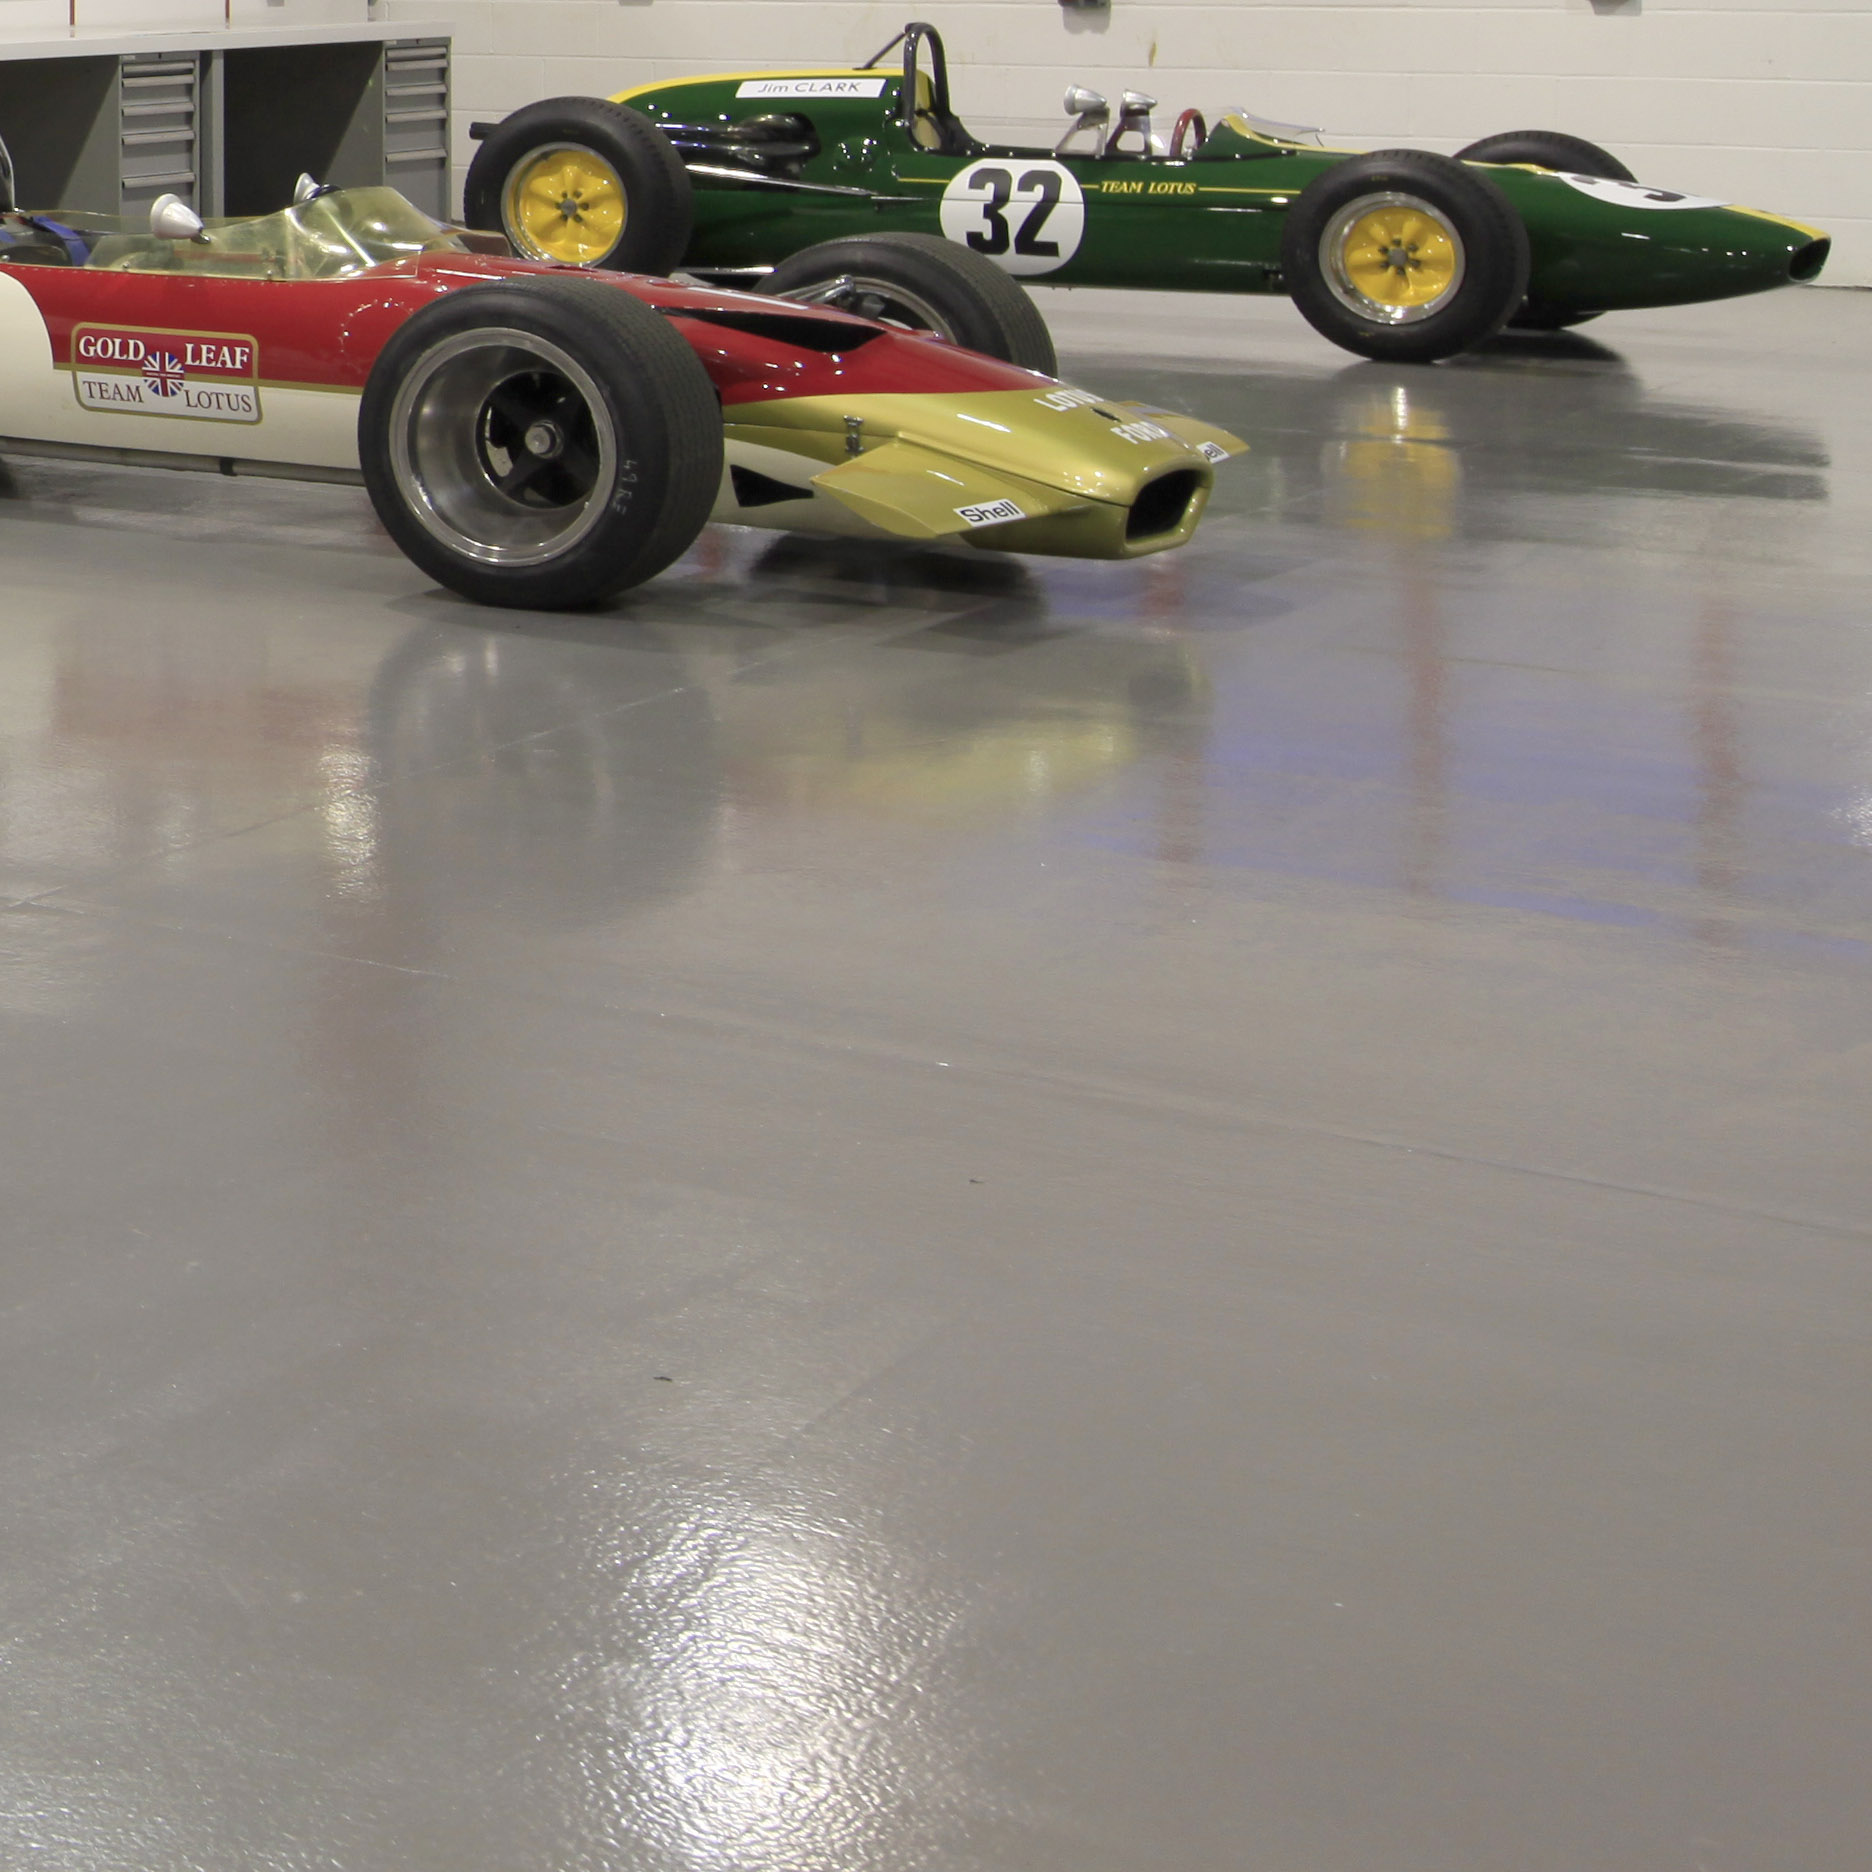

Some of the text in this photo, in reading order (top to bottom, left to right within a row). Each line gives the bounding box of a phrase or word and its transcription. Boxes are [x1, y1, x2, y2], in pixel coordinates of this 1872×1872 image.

[757, 81, 862, 94] Jim CLARK
[1098, 181, 1198, 195] TEAM LOTUS
[966, 167, 1063, 258] 32
[78, 335, 250, 370] GOLD LEAF
[82, 380, 253, 414] TEAM LOTUS
[960, 501, 1020, 523] Shell
